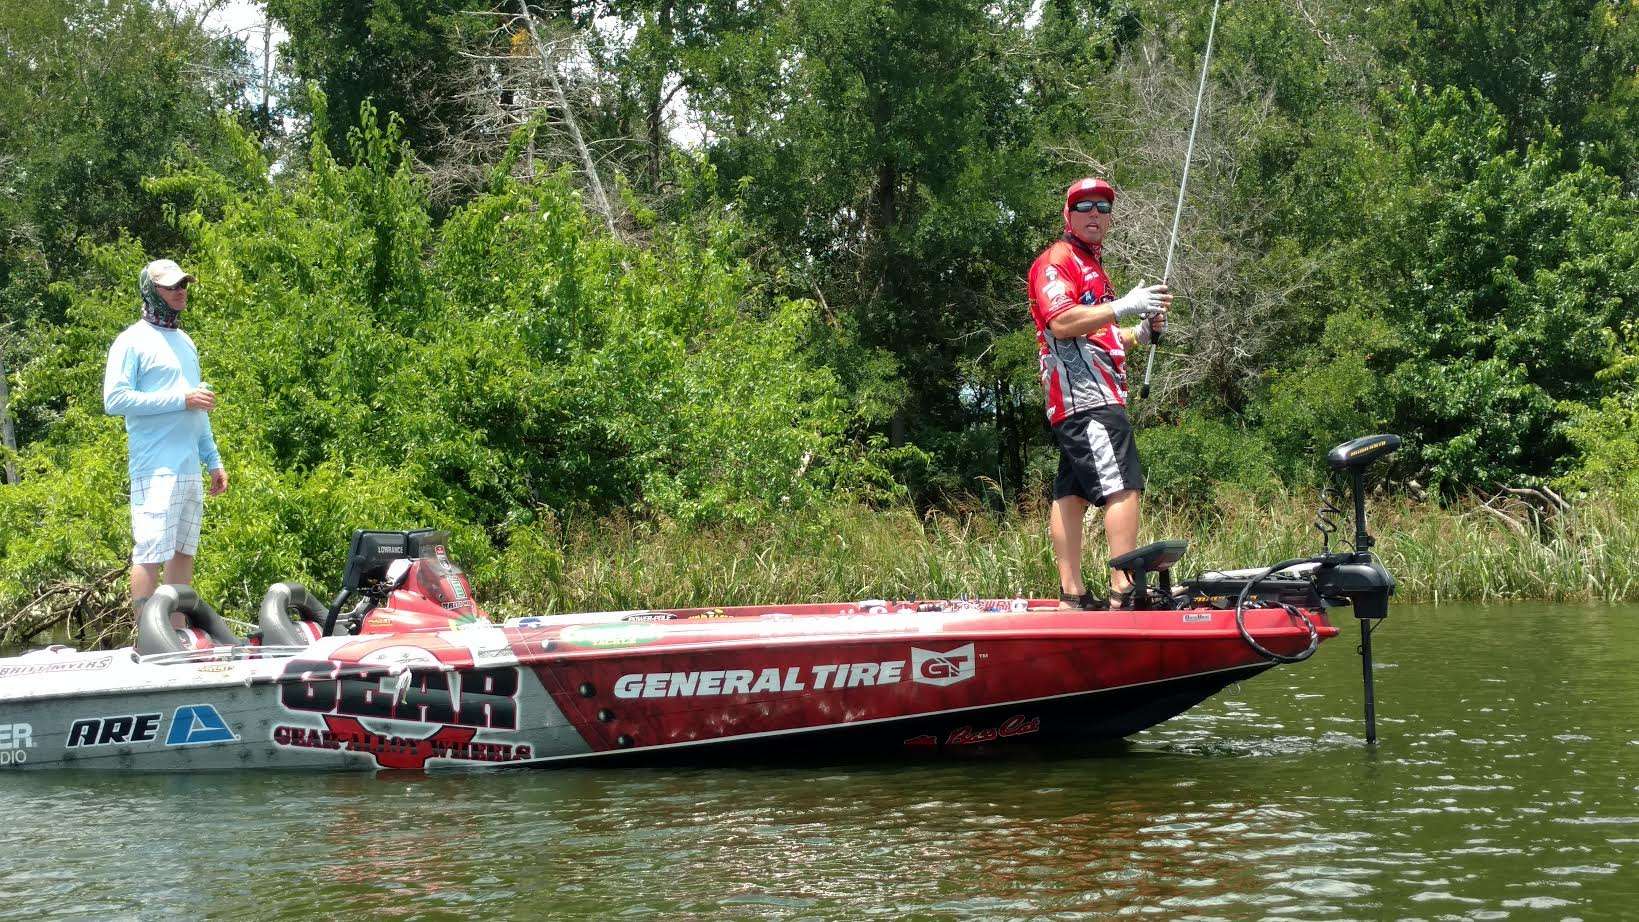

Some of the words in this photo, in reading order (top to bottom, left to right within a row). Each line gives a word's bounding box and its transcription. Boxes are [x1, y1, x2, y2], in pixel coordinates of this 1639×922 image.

[377, 543, 404, 554] LOWRANCE
[280, 658, 519, 730] GEAR
[613, 668, 805, 699] GENERAL
[811, 660, 905, 690] TIRE
[66, 713, 163, 748] ARE
[273, 725, 342, 750] GEAR
[430, 741, 533, 761] WHEELS
